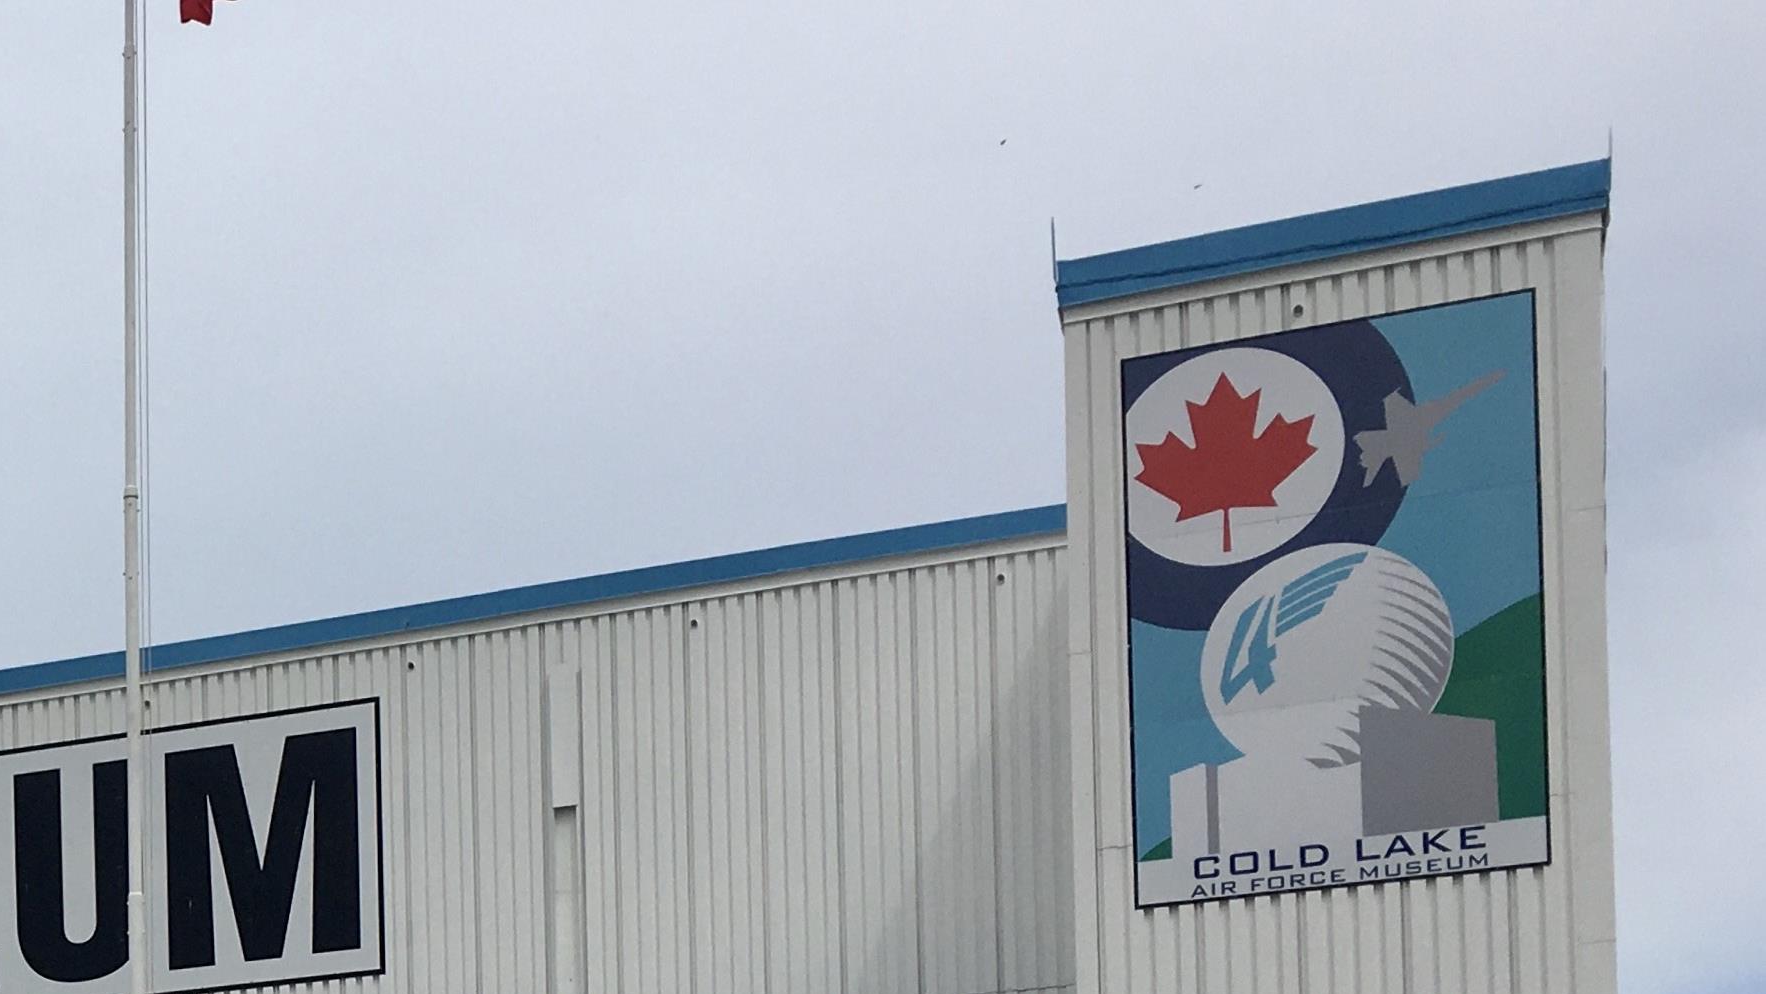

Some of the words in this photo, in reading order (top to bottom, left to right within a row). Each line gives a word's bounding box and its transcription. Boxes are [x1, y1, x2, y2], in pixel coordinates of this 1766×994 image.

[1190, 880, 1238, 899] AIR
[1250, 868, 1346, 894] FORCE
[1359, 852, 1490, 881] MUSEUM
[1192, 843, 1330, 880] COLD
[1355, 825, 1487, 862] LAKE
